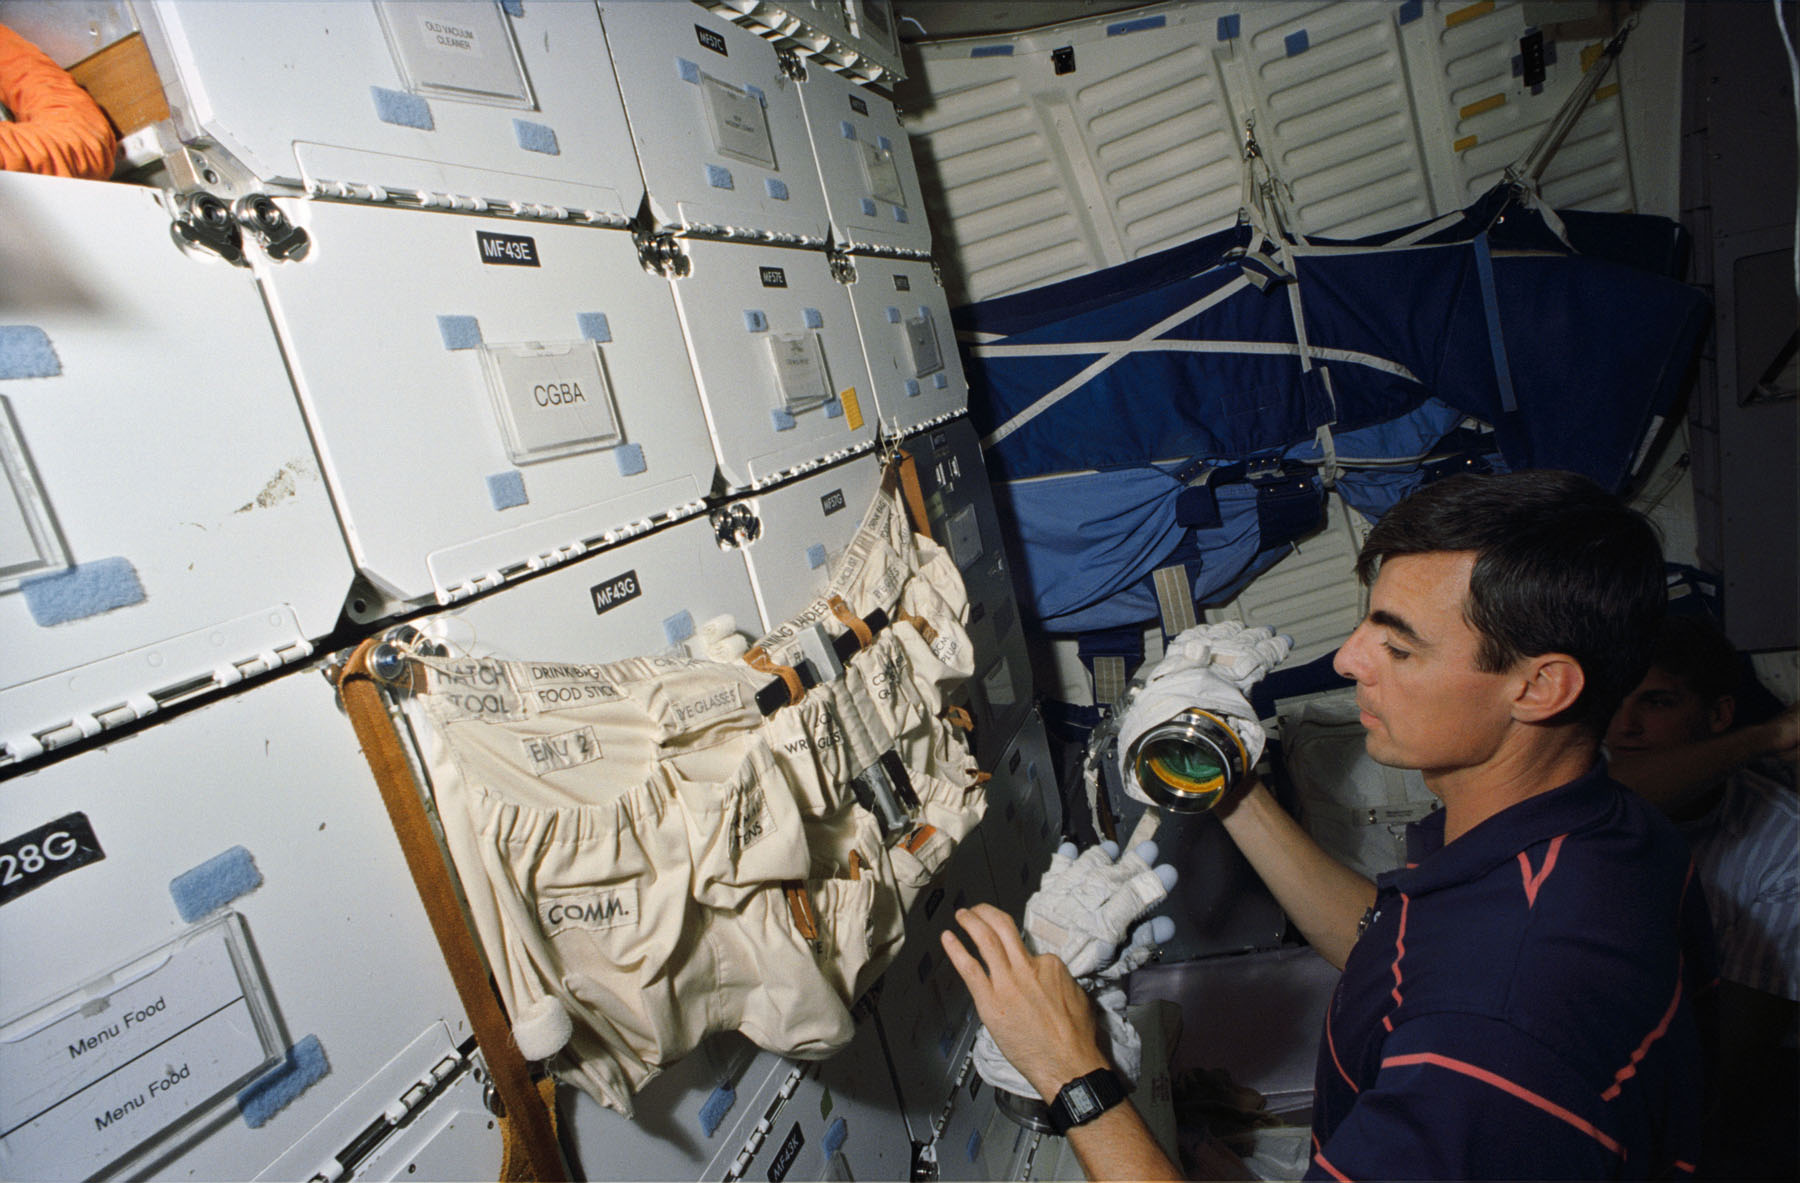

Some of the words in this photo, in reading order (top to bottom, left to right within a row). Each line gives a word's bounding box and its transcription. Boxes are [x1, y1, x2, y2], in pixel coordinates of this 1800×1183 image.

[436, 34, 471, 50] CLEANER
[482, 238, 532, 260] MF43E
[533, 382, 586, 407] CGBA
[596, 578, 635, 608] MF43G
[437, 663, 507, 685] HATCH
[532, 666, 575, 680] DRINK
[449, 694, 510, 714] TOOL
[538, 687, 582, 704] FOOD
[0, 831, 78, 886] 28G
[548, 896, 630, 925] COMM.
[68, 1023, 121, 1060] Menu
[123, 996, 167, 1030] Food
[94, 1095, 145, 1131] Menu
[148, 1063, 191, 1099] Food
[773, 1132, 799, 1181] MF43K
